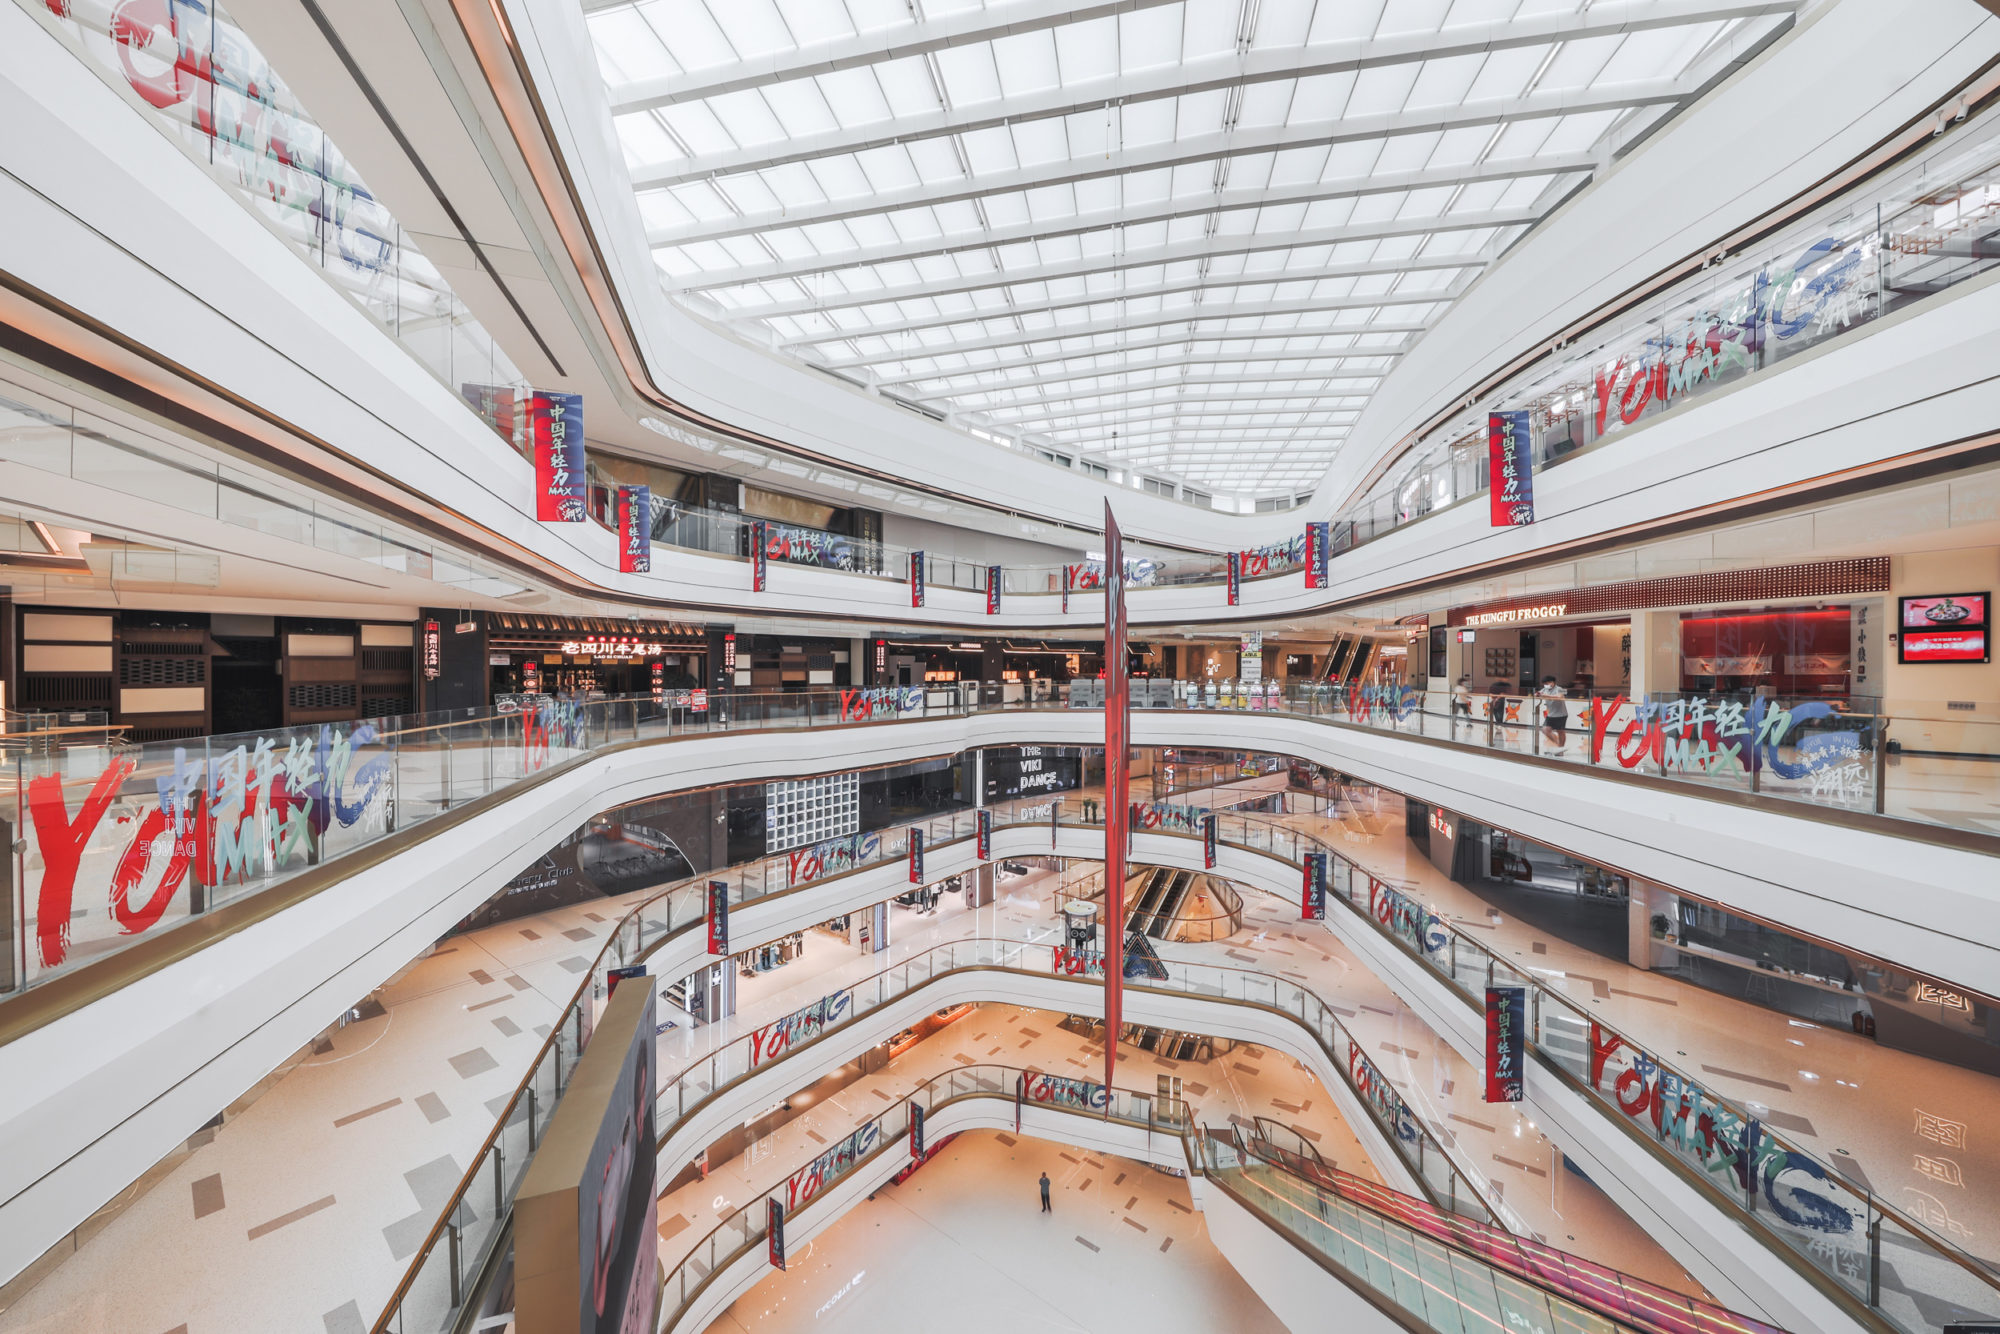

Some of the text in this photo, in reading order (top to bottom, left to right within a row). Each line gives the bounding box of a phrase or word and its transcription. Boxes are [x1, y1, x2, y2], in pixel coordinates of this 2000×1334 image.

[549, 404, 569, 486] 中国年轻力
[1502, 421, 1519, 494] 中国年轻力
[1466, 605, 1567, 626] THE KUNGFU FROGGY
[561, 641, 662, 656] 老四川牛尾汤
[872, 703, 896, 717] MAX
[1635, 694, 1793, 747] 中国年轻力
[1020, 746, 1042, 757] THE
[1020, 759, 1042, 772] VIKI
[1664, 736, 1742, 782] MAX
[1020, 772, 1057, 789] DANCE
[1497, 997, 1512, 1070] 中国年轻力
[1633, 1049, 1788, 1180] 中国年轻力
[1661, 1104, 1739, 1195] MAX
